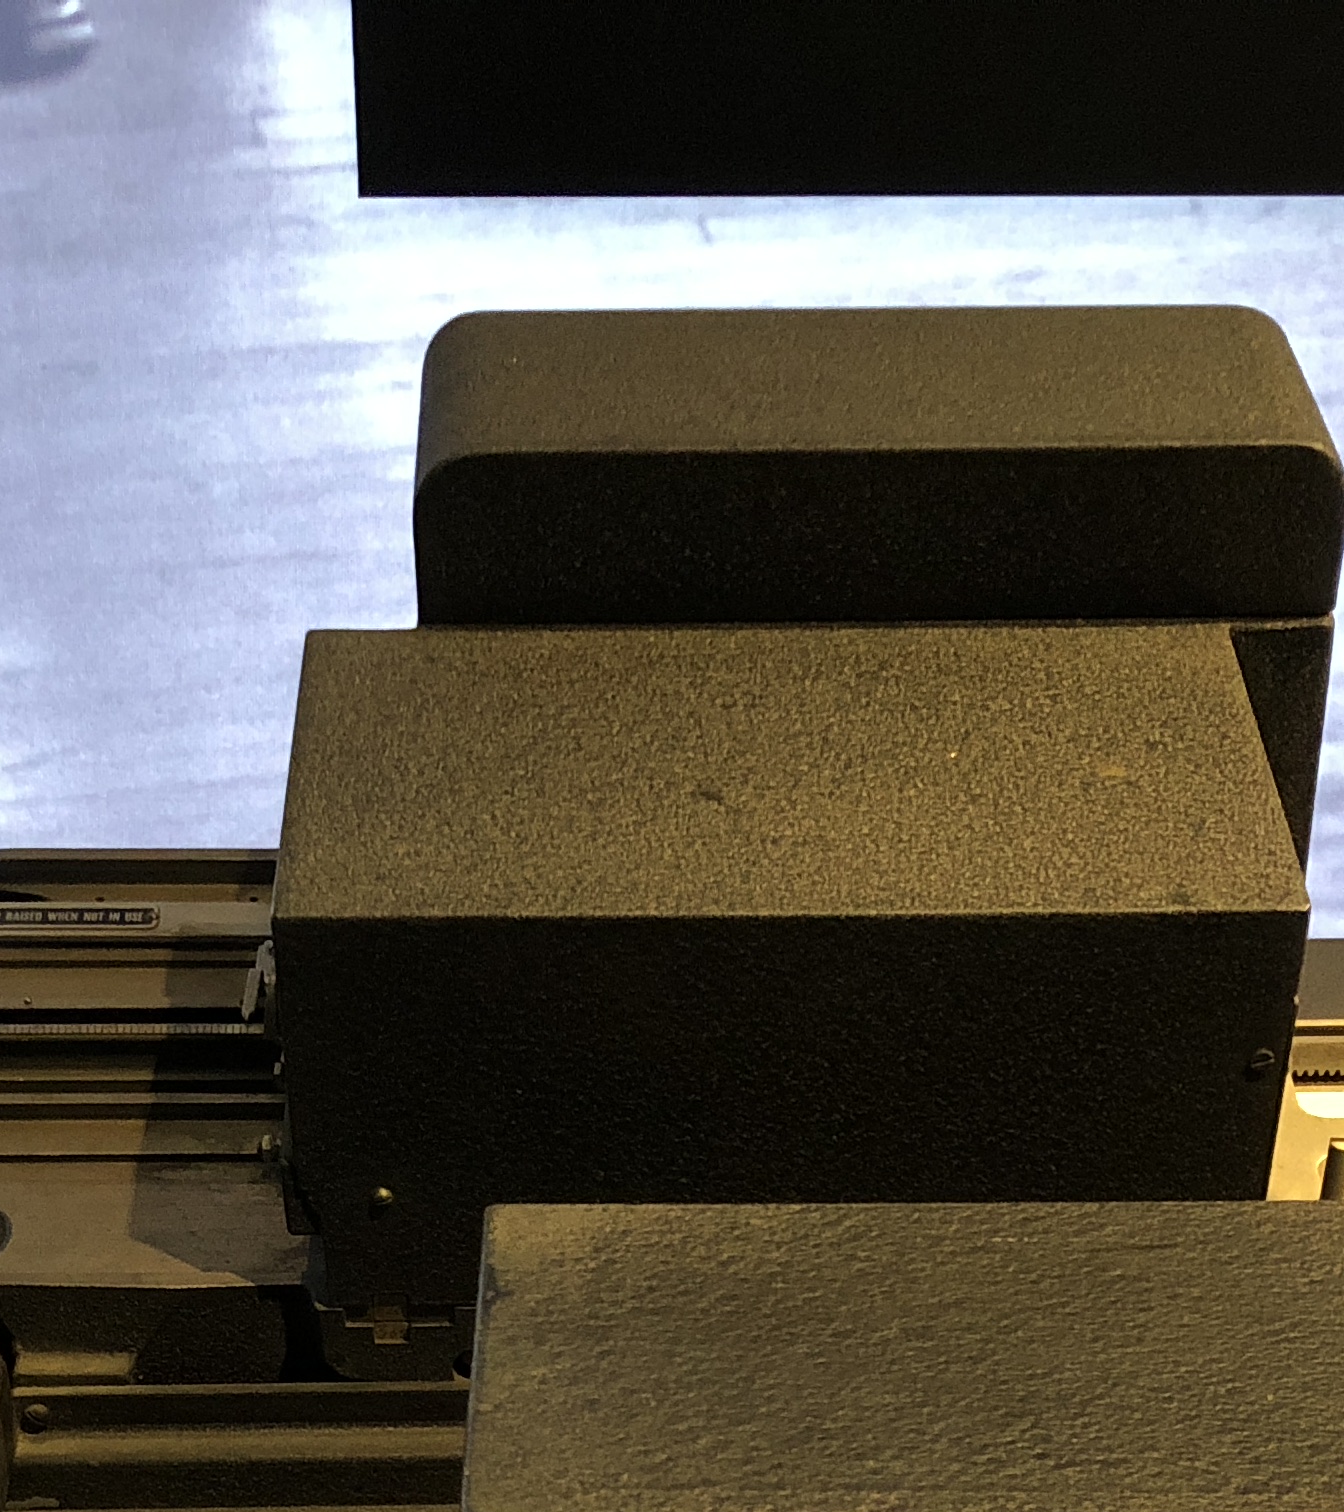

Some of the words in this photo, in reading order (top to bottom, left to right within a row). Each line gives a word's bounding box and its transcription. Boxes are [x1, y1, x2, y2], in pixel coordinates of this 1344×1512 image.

[6, 912, 43, 922] RAISED
[48, 912, 78, 922] WHEN
[83, 912, 105, 922] NOT
[109, 912, 120, 922] IN
[124, 912, 144, 922] USE
